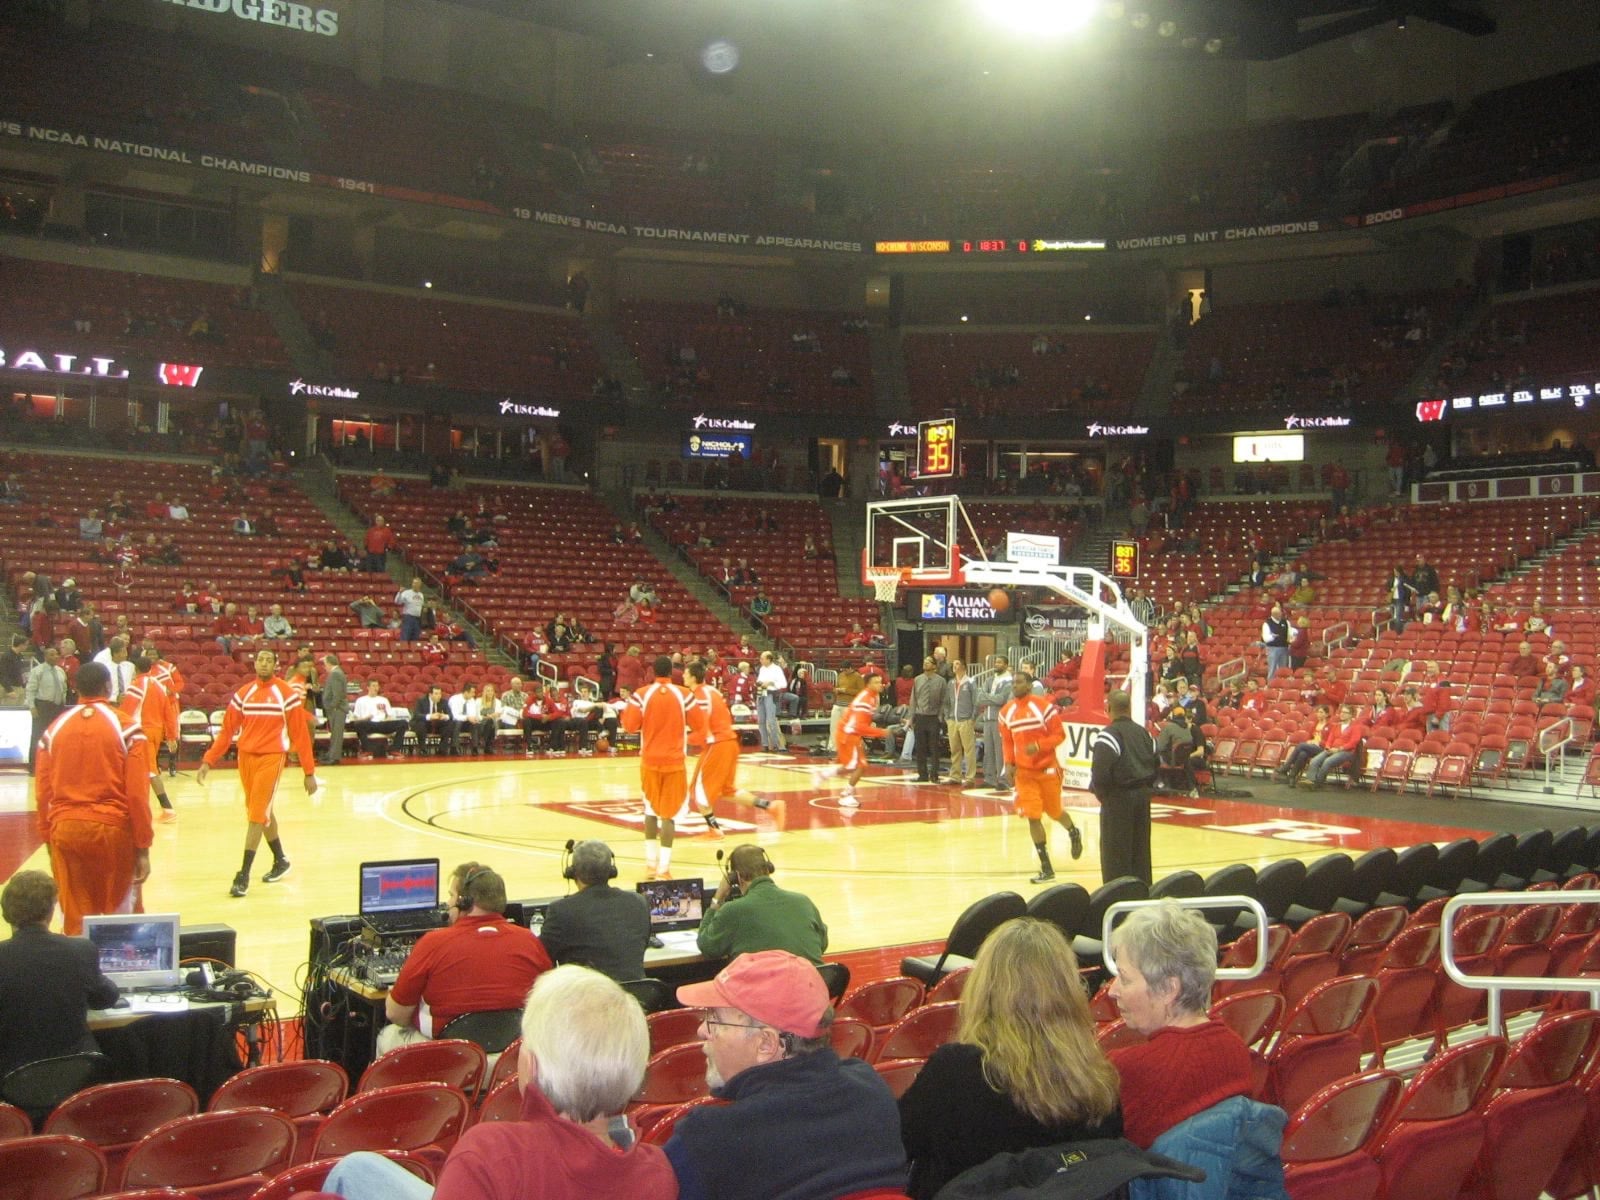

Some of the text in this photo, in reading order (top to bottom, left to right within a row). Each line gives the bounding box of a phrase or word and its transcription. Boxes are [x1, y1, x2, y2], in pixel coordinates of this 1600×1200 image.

[162, 0, 338, 36] DGERS
[0, 121, 374, 193] 'S NCAA NATIONAL CHAMPIONS 1941
[536, 211, 581, 227] MEN'S
[586, 219, 627, 235] NCAA
[634, 226, 749, 244] TOURNAMENT
[755, 235, 861, 252] APPEARANCES
[1116, 234, 1186, 250] WOMEN'S
[1193, 231, 1218, 242] NIT
[1224, 220, 1319, 240] CHAMPIONS
[1365, 208, 1402, 225] 2000
[0, 348, 129, 378] ALL
[927, 443, 949, 470] 35
[1117, 558, 1131, 572] 35
[947, 595, 991, 607] ALLIAN
[947, 607, 997, 619] ENERGY
